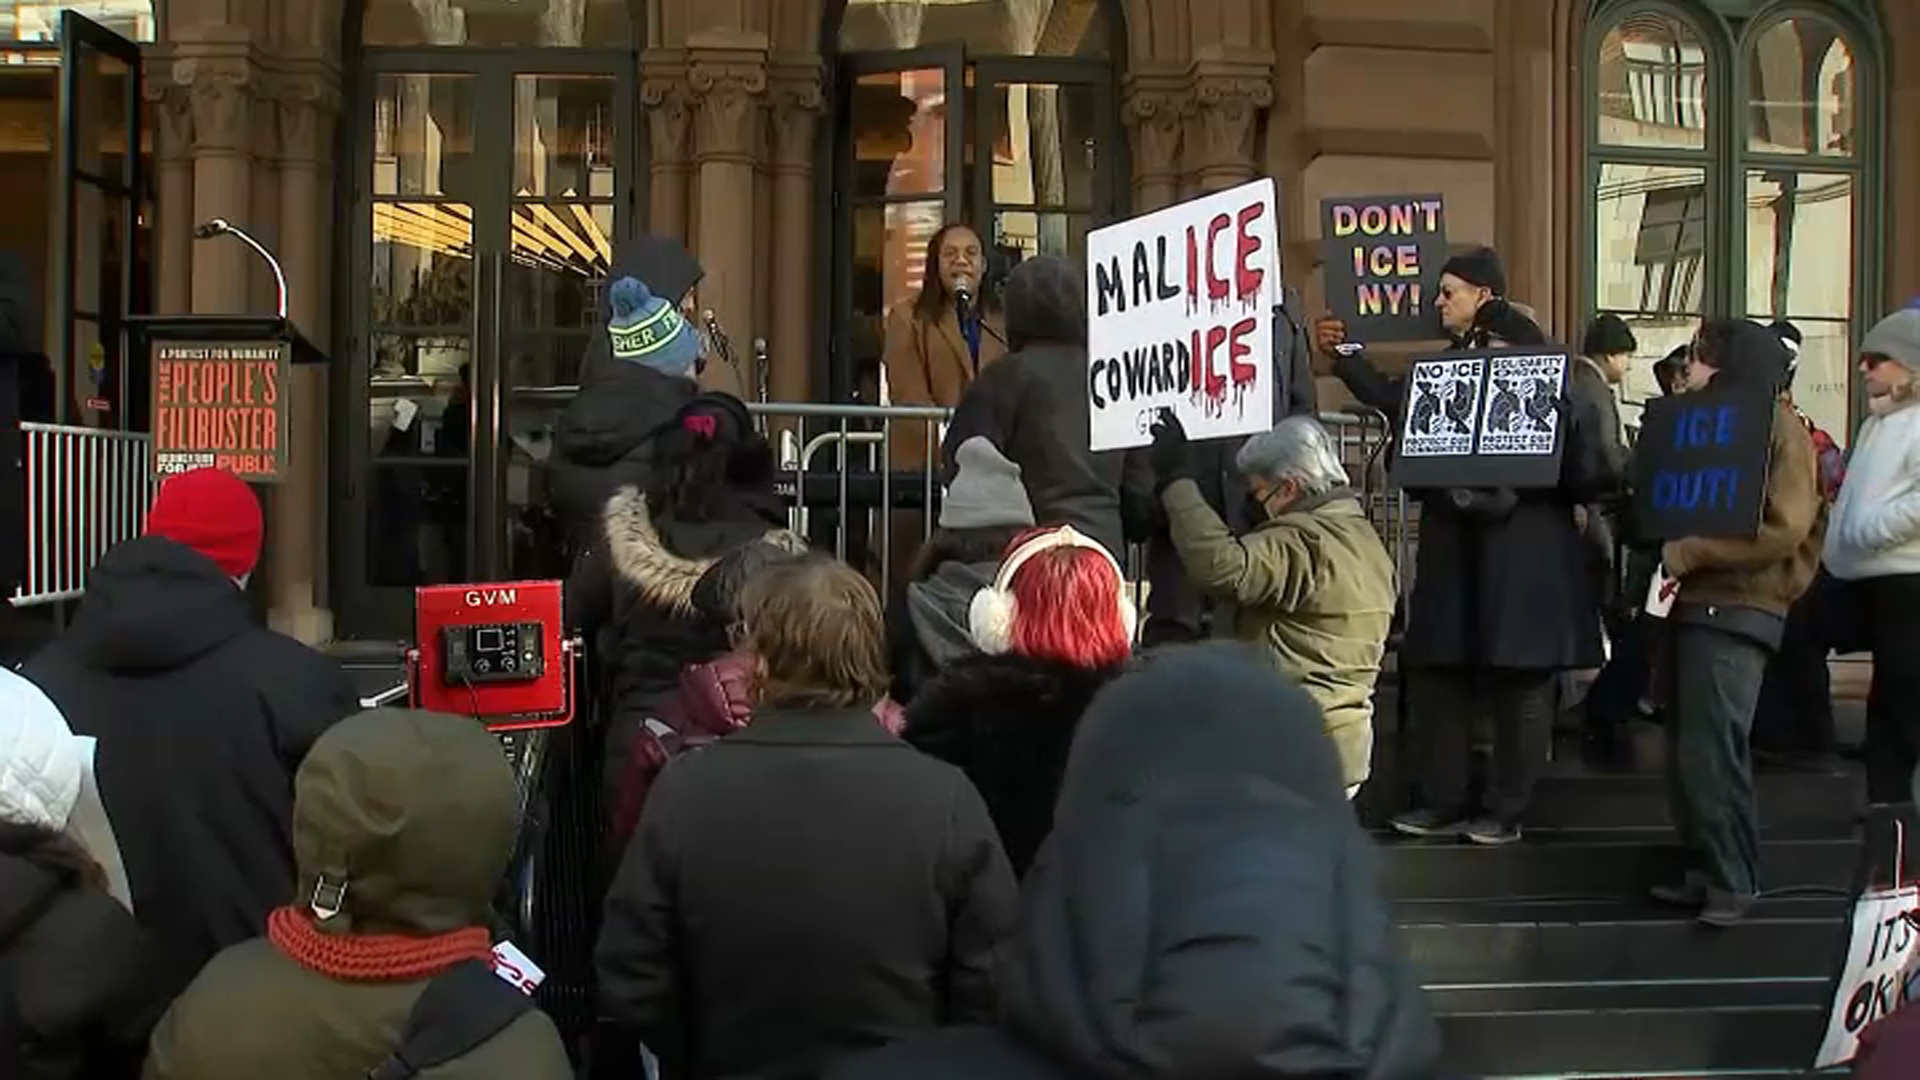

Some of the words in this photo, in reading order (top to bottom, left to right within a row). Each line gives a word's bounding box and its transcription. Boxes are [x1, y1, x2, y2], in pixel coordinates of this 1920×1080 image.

[1333, 200, 1441, 236] DON'T
[1095, 201, 1266, 317] MALICE
[1354, 244, 1421, 277] ICE
[1358, 283, 1421, 316] NY!
[173, 361, 277, 404] PEOPLE'S
[1090, 317, 1257, 410] COWARDICE
[158, 407, 277, 450] FILIBUSTER
[1674, 405, 1733, 450] ICE
[465, 588, 517, 607] GVM
